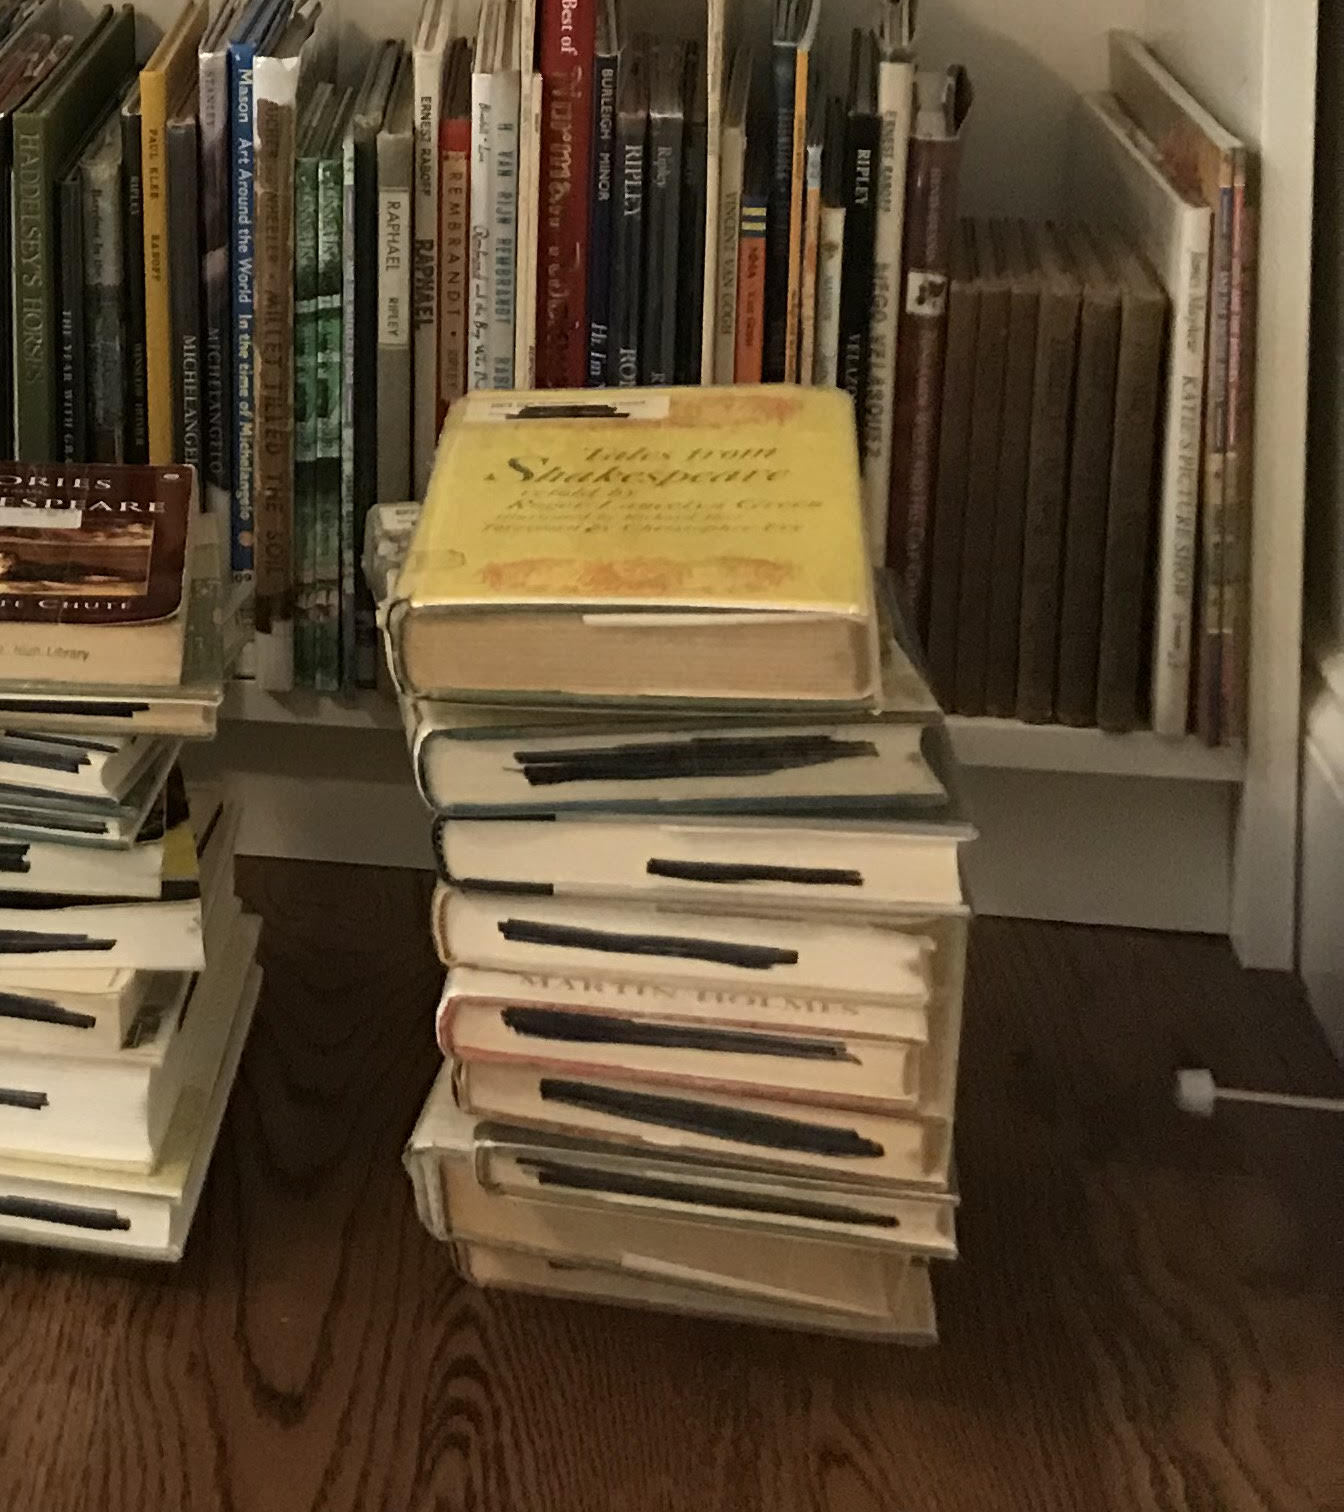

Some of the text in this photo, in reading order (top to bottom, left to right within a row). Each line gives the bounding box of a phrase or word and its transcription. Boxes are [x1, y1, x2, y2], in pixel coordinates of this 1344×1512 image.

[562, 35, 576, 55] of
[238, 69, 253, 123] Mason
[150, 129, 160, 158] PAUL
[238, 137, 252, 164] Art
[598, 69, 613, 200] BURLEIGH MINOR
[150, 163, 160, 199] KLEE
[238, 169, 253, 224] Around
[625, 146, 642, 215] RIPLEY
[856, 150, 871, 207] RIPLEY
[416, 97, 434, 330] ERNEST RABOFF RAPHAEL
[238, 228, 252, 253] the
[448, 170, 461, 321] REMBRANDT
[239, 259, 253, 303] World
[388, 202, 400, 337] RAPHAEL RIPLEY
[720, 192, 736, 334] VINCENT VAN GOGH
[239, 333, 252, 359] the
[239, 363, 253, 397] time
[239, 401, 253, 419] of
[236, 422, 253, 521] Michelangelo
[508, 458, 790, 484] Shakespeare
[39, 600, 129, 610] CHUTE
[518, 975, 860, 1017] MARTIN HOLMES
